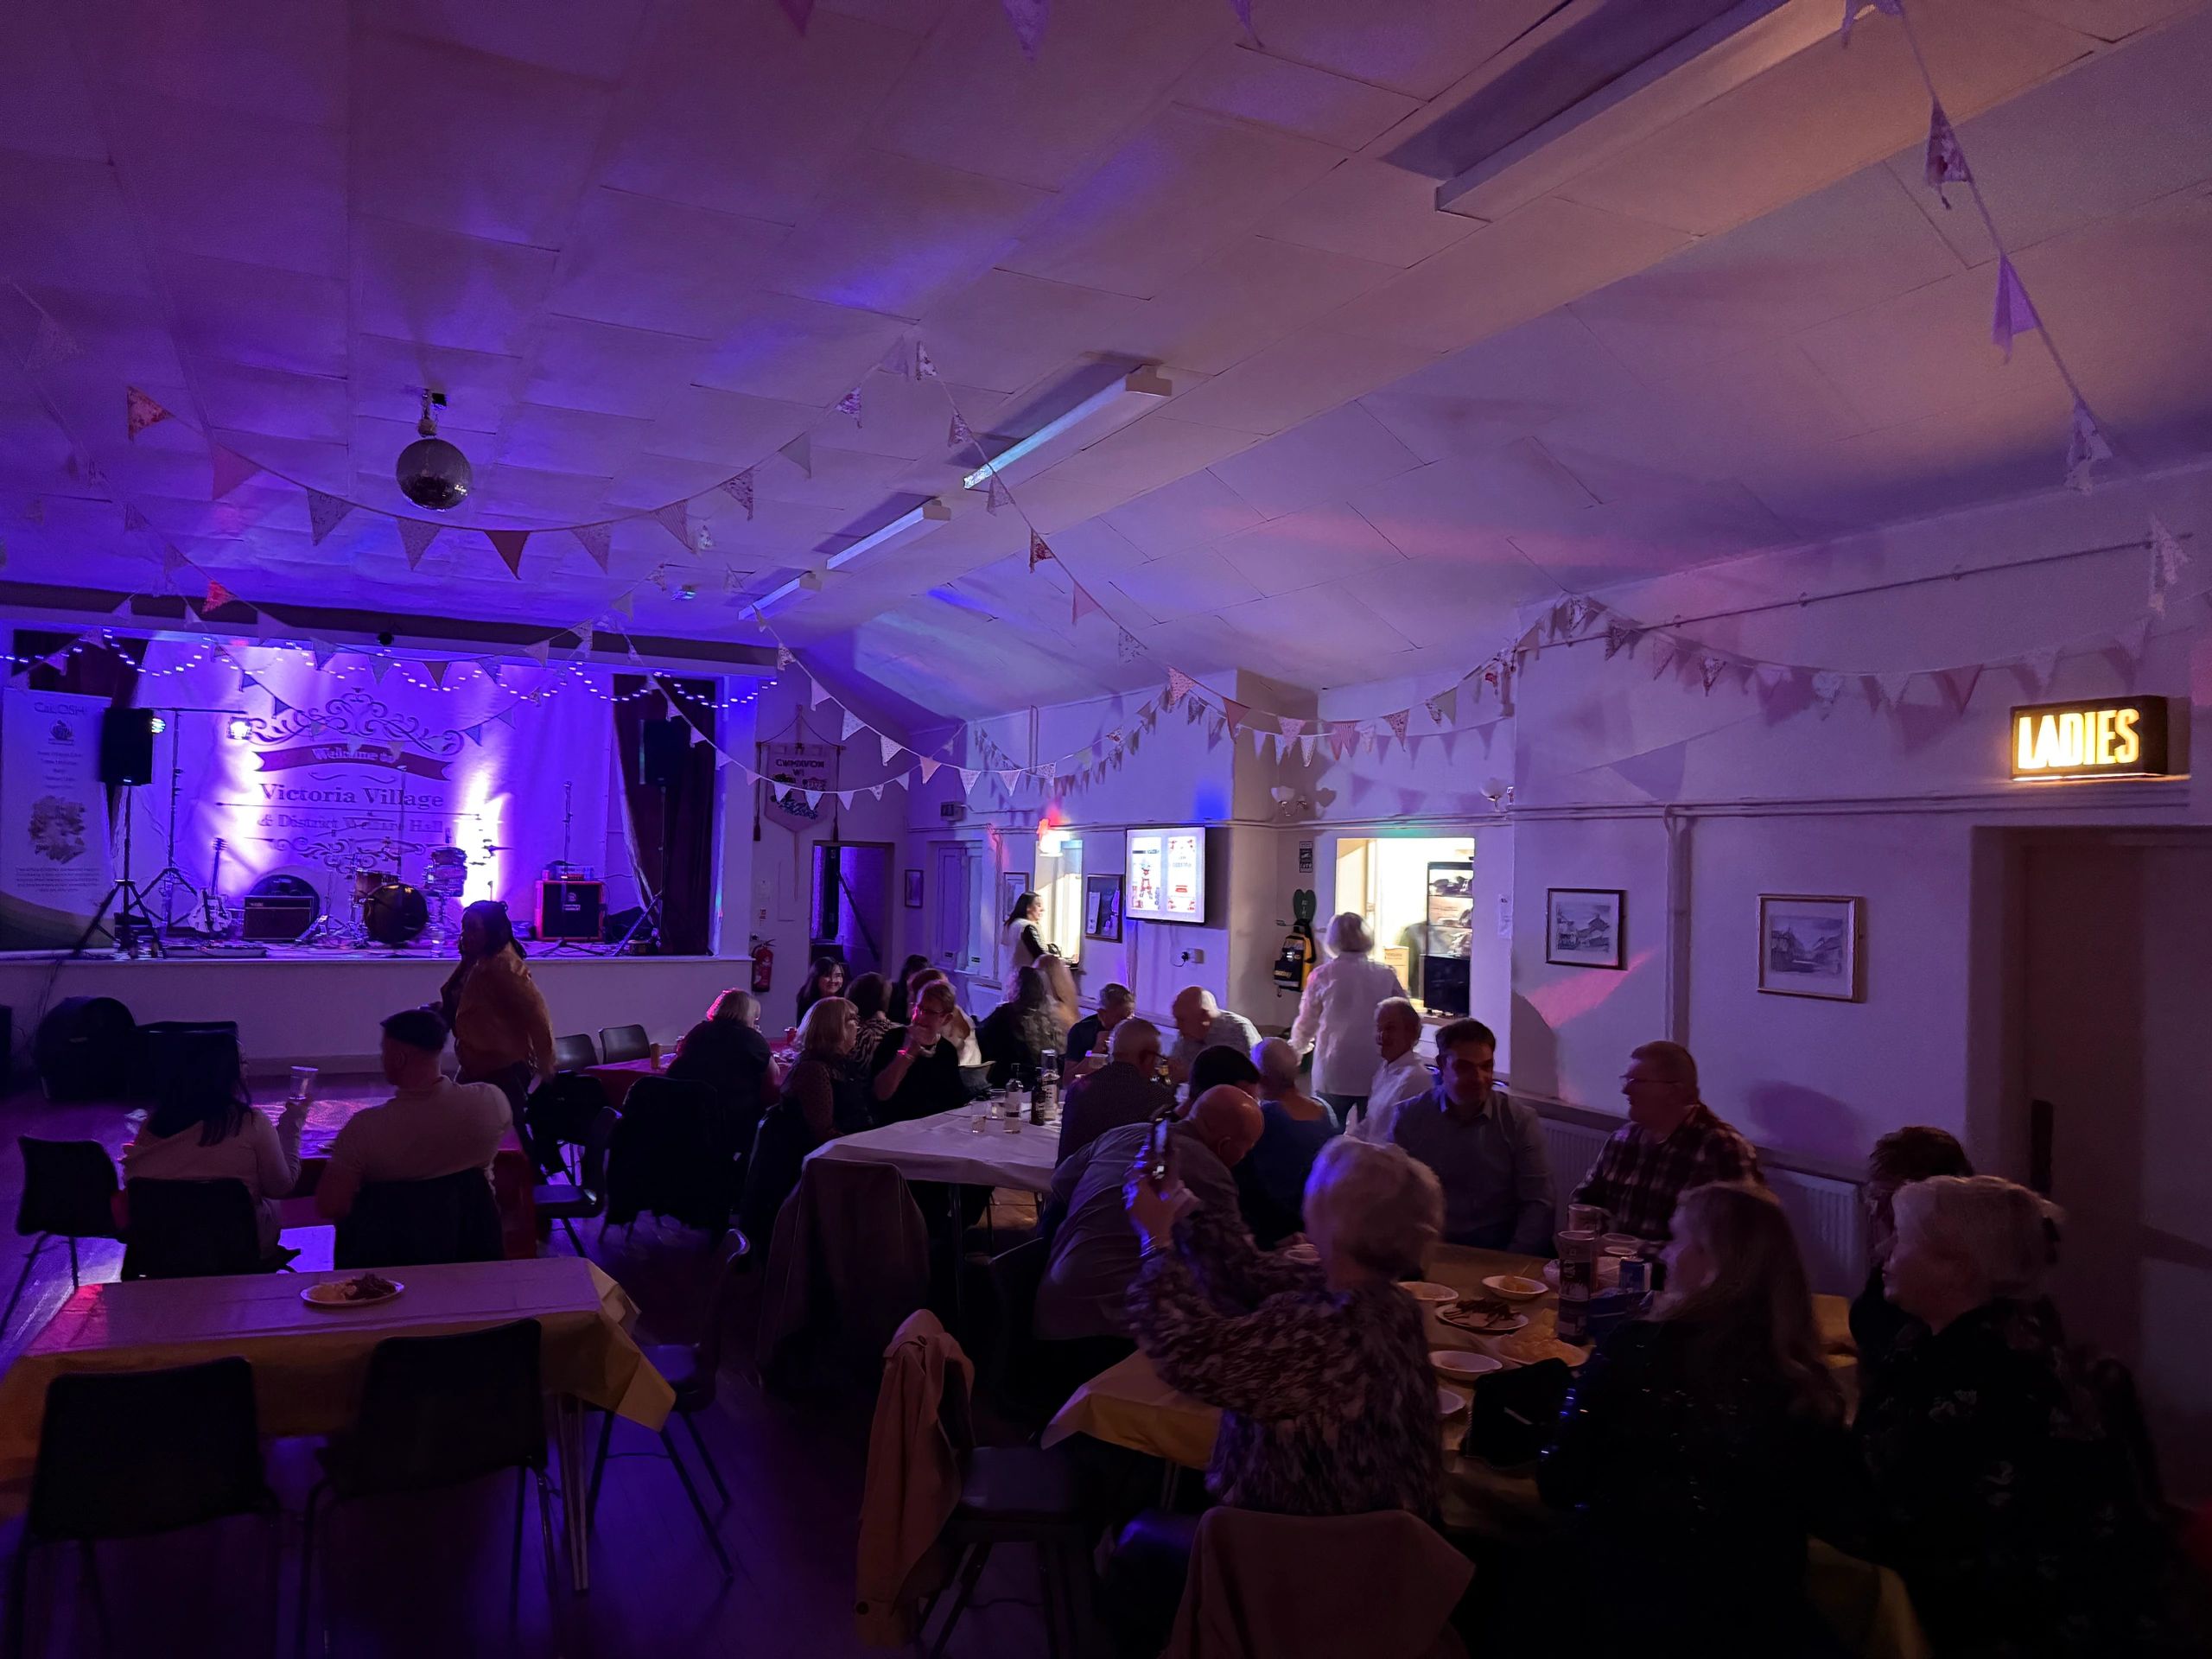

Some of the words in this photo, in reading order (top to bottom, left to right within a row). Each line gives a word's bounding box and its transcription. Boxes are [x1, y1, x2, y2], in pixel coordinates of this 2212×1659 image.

[2018, 708, 2140, 770] LADIES
[311, 747, 378, 761] Welcme
[259, 783, 357, 804] Victoria
[363, 787, 443, 810] Village
